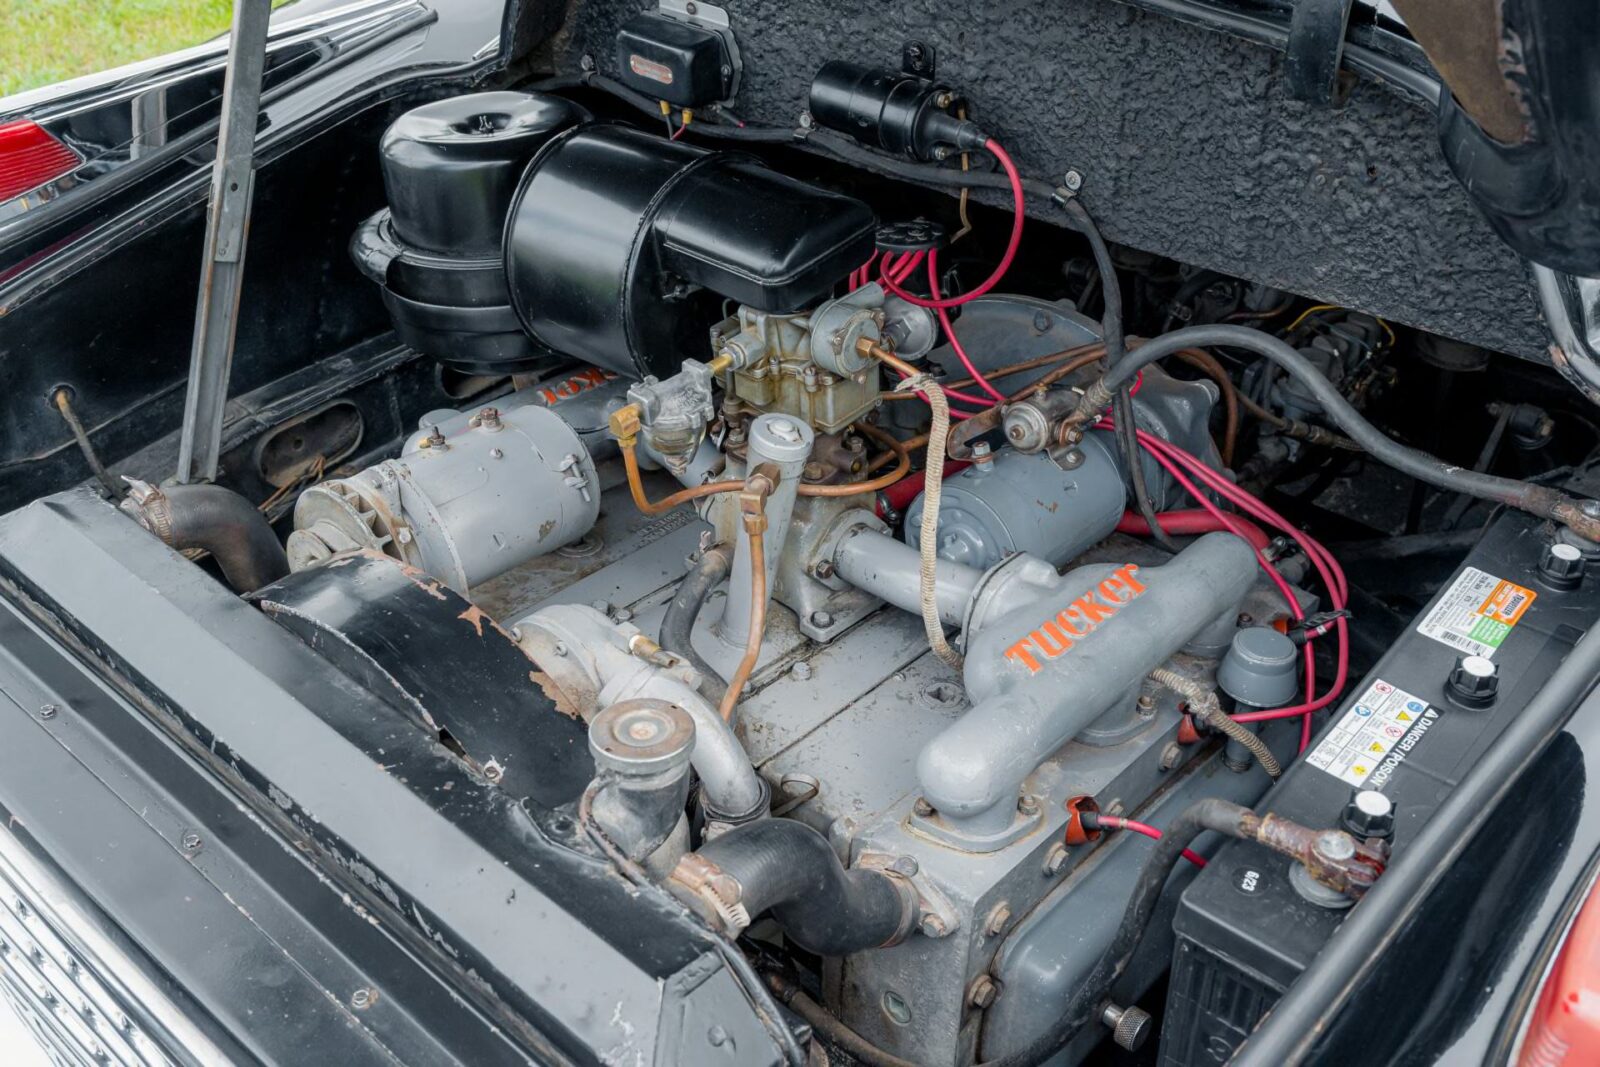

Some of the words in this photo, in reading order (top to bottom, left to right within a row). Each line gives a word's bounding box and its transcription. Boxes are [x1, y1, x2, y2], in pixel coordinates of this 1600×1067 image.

[1397, 717, 1433, 752] DANGER
[1370, 752, 1404, 786] POISON
[1242, 870, 1260, 891] 6/23
